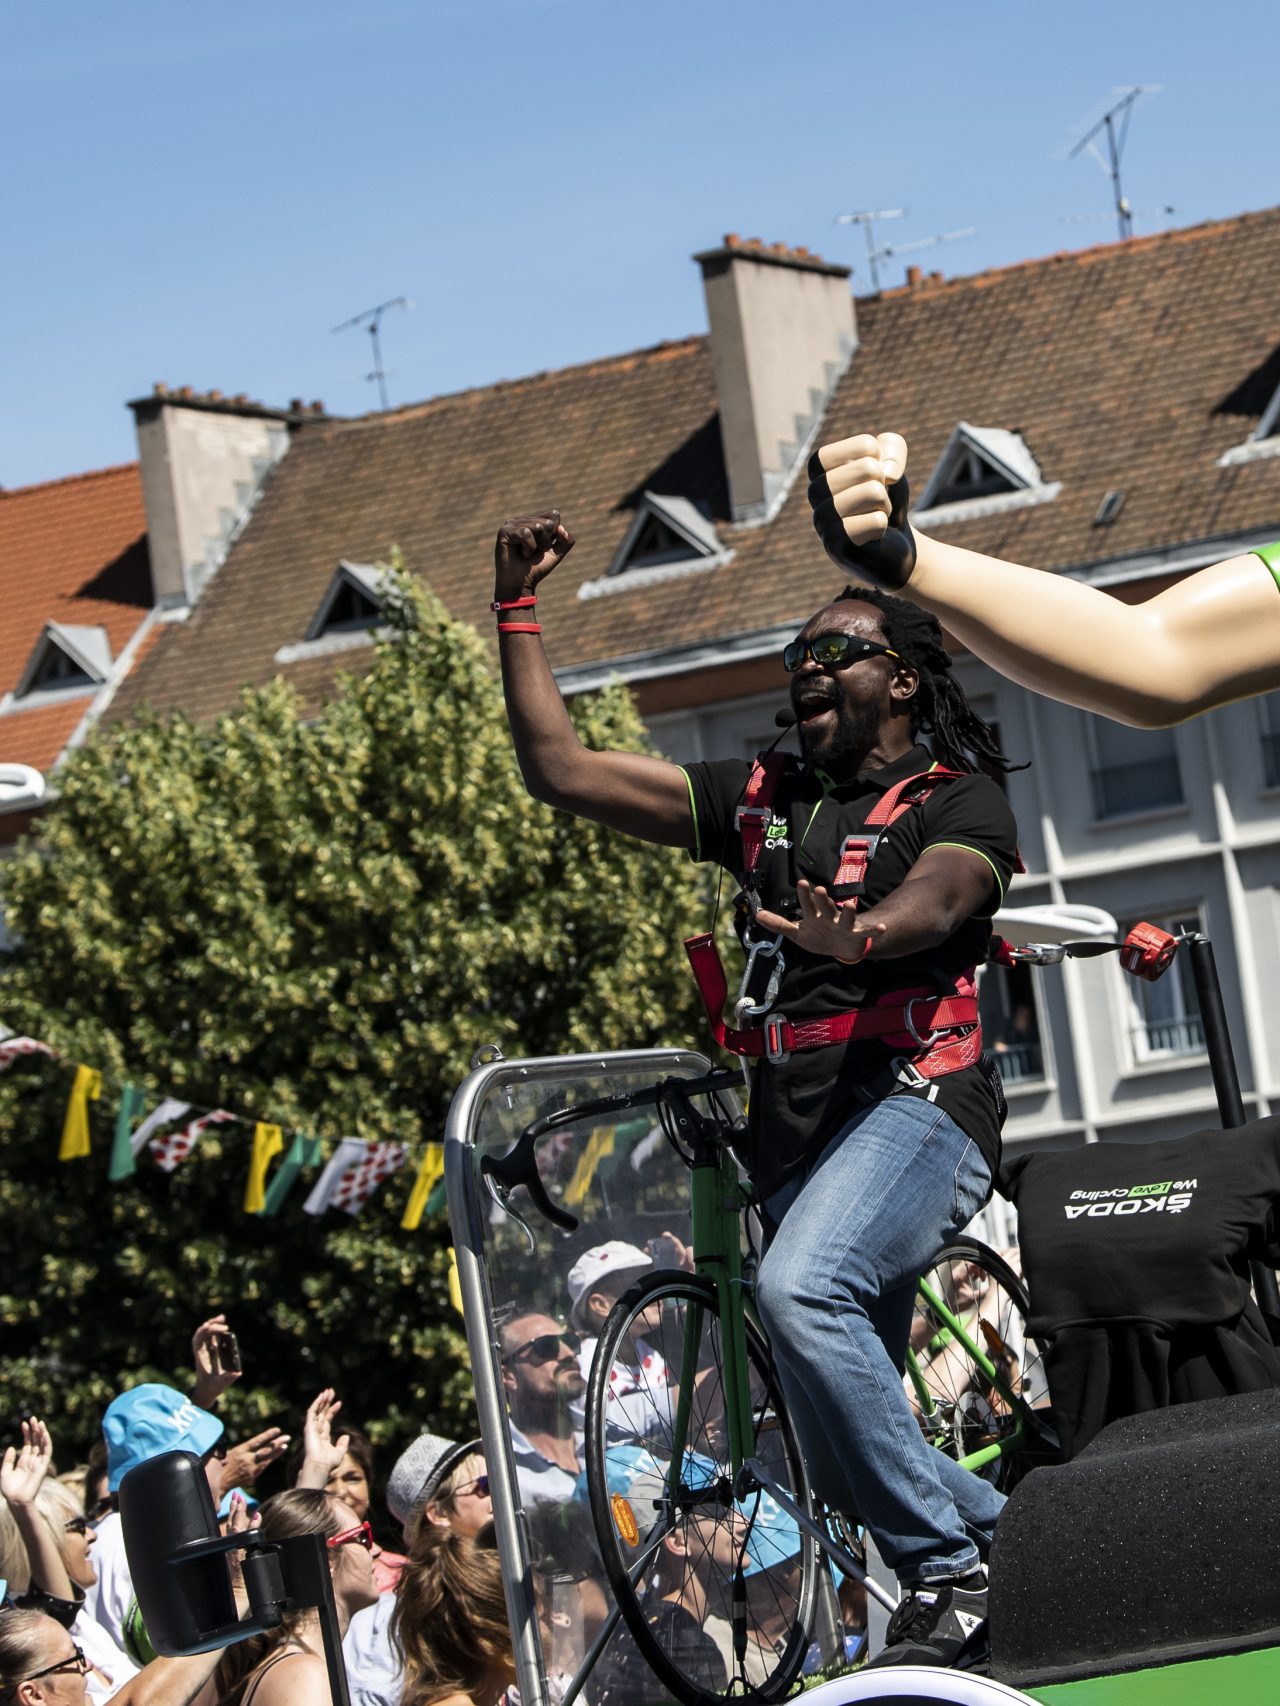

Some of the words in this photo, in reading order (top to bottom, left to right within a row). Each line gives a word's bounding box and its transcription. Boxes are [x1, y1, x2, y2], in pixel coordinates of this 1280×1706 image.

[1172, 1179, 1197, 1190] We
[1069, 1188, 1129, 1201] Cycling
[1064, 1192, 1193, 1219] ŠKODA
